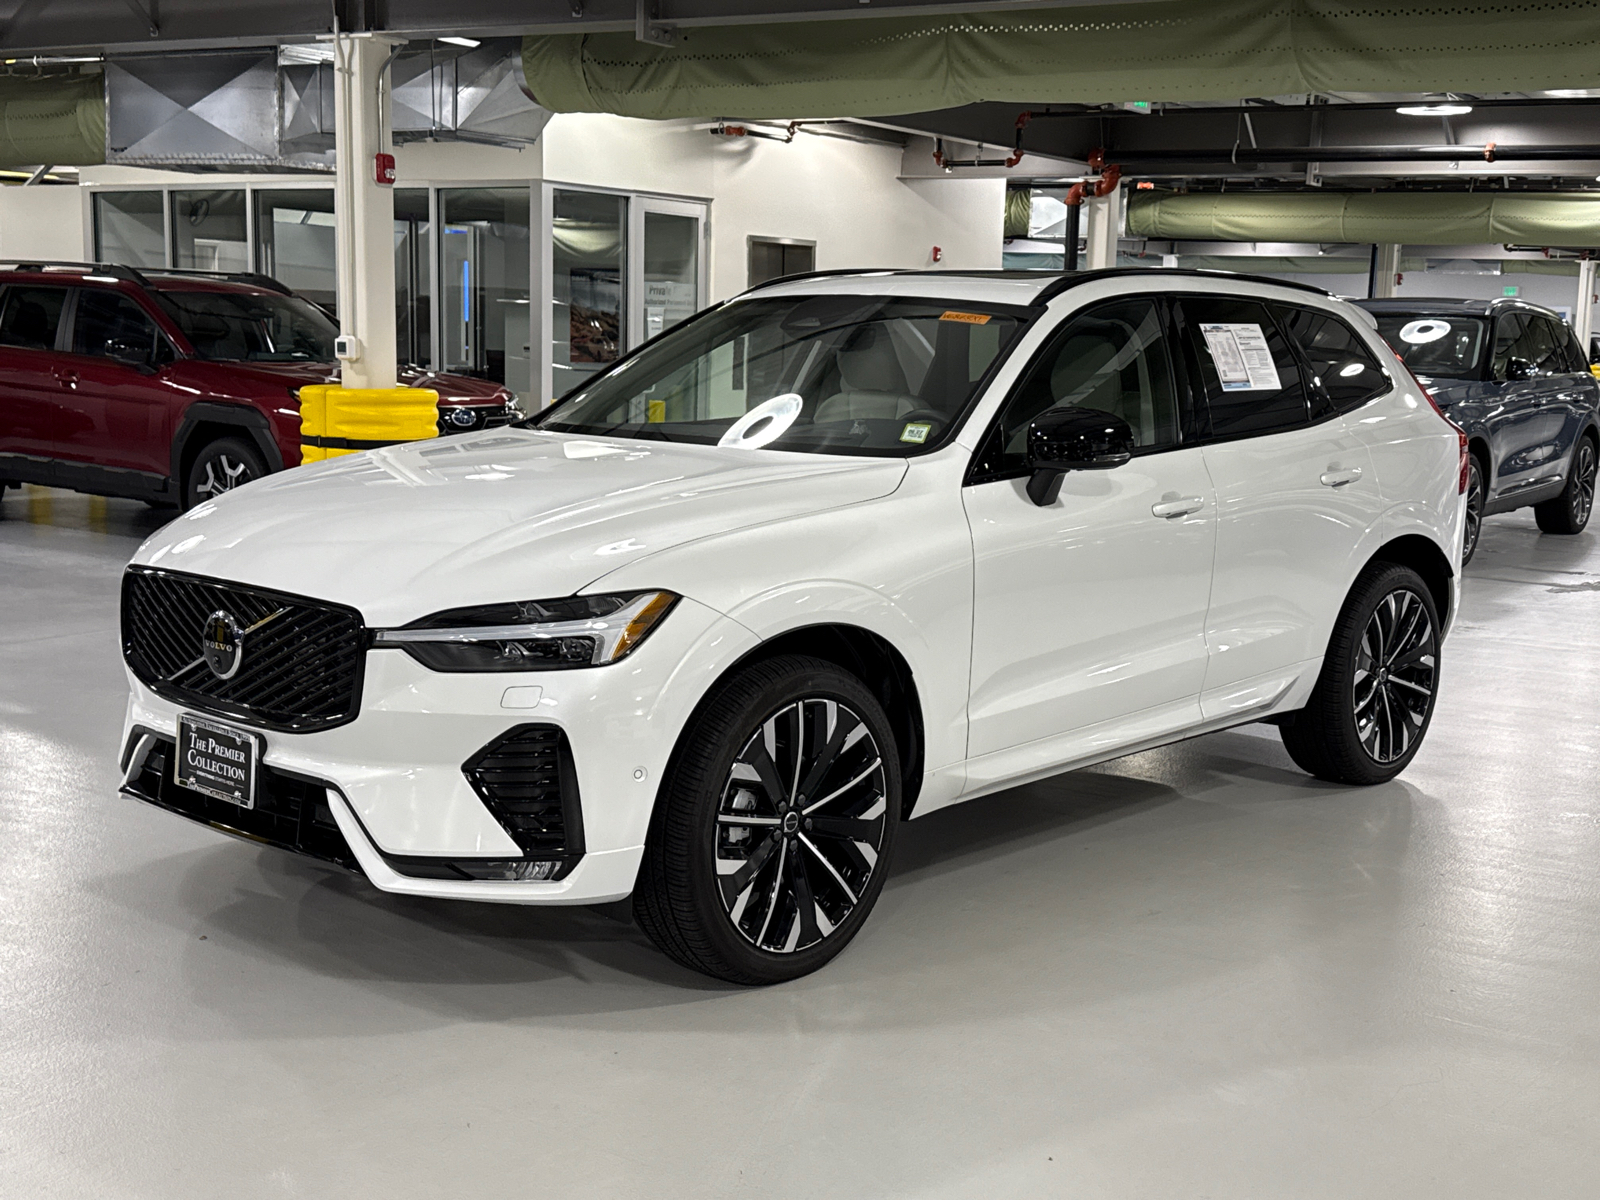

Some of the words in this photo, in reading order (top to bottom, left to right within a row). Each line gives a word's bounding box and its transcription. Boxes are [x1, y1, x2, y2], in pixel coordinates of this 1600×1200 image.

[205, 640, 233, 652] VOLVO
[189, 732, 207, 752] THE
[208, 738, 246, 764] PREMIER
[187, 749, 245, 781] COLLECTION
